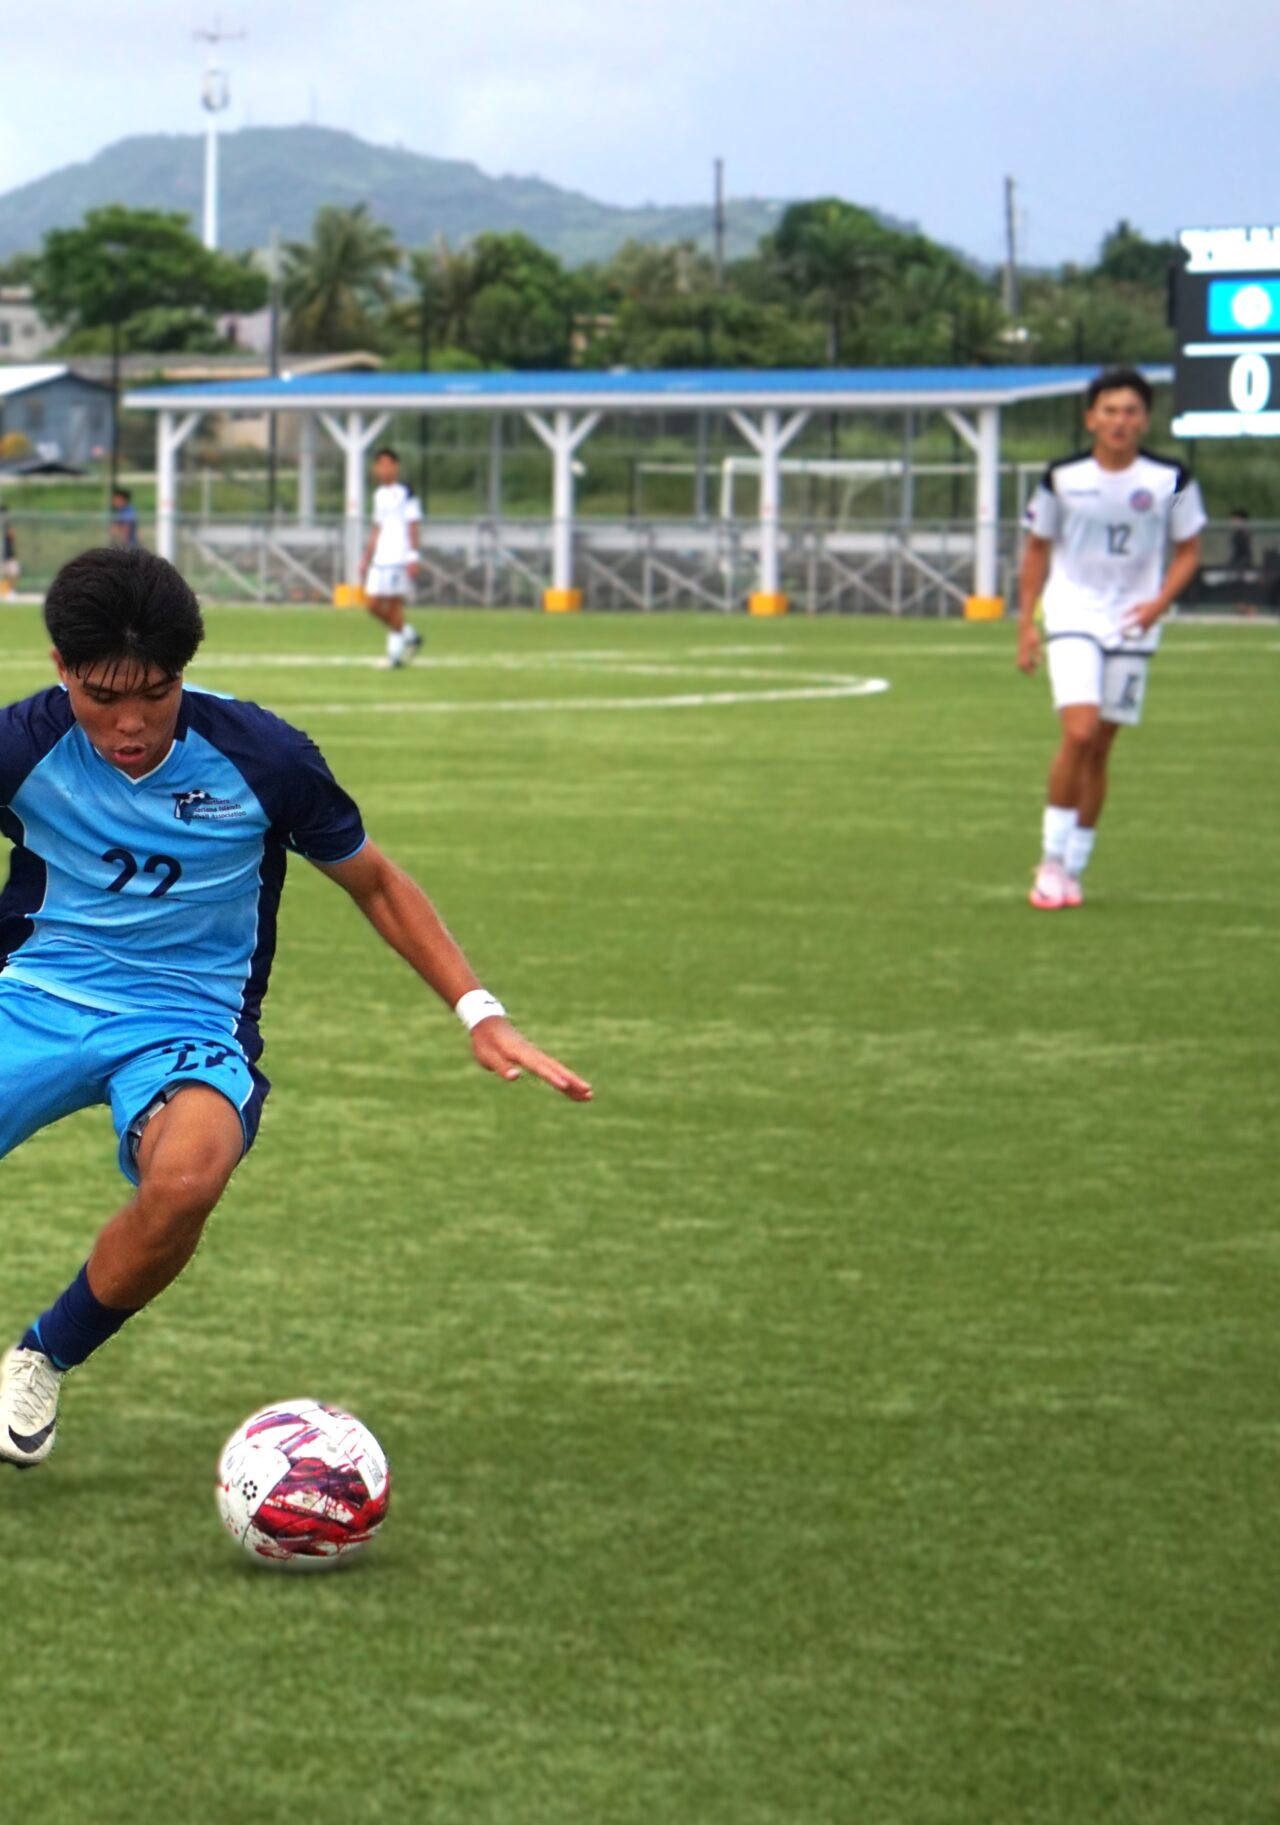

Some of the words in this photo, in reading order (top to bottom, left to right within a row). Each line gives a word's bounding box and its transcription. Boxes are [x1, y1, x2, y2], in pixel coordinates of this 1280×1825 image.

[1229, 353, 1270, 413] 0
[1107, 523, 1132, 556] 12
[101, 847, 182, 900] 22
